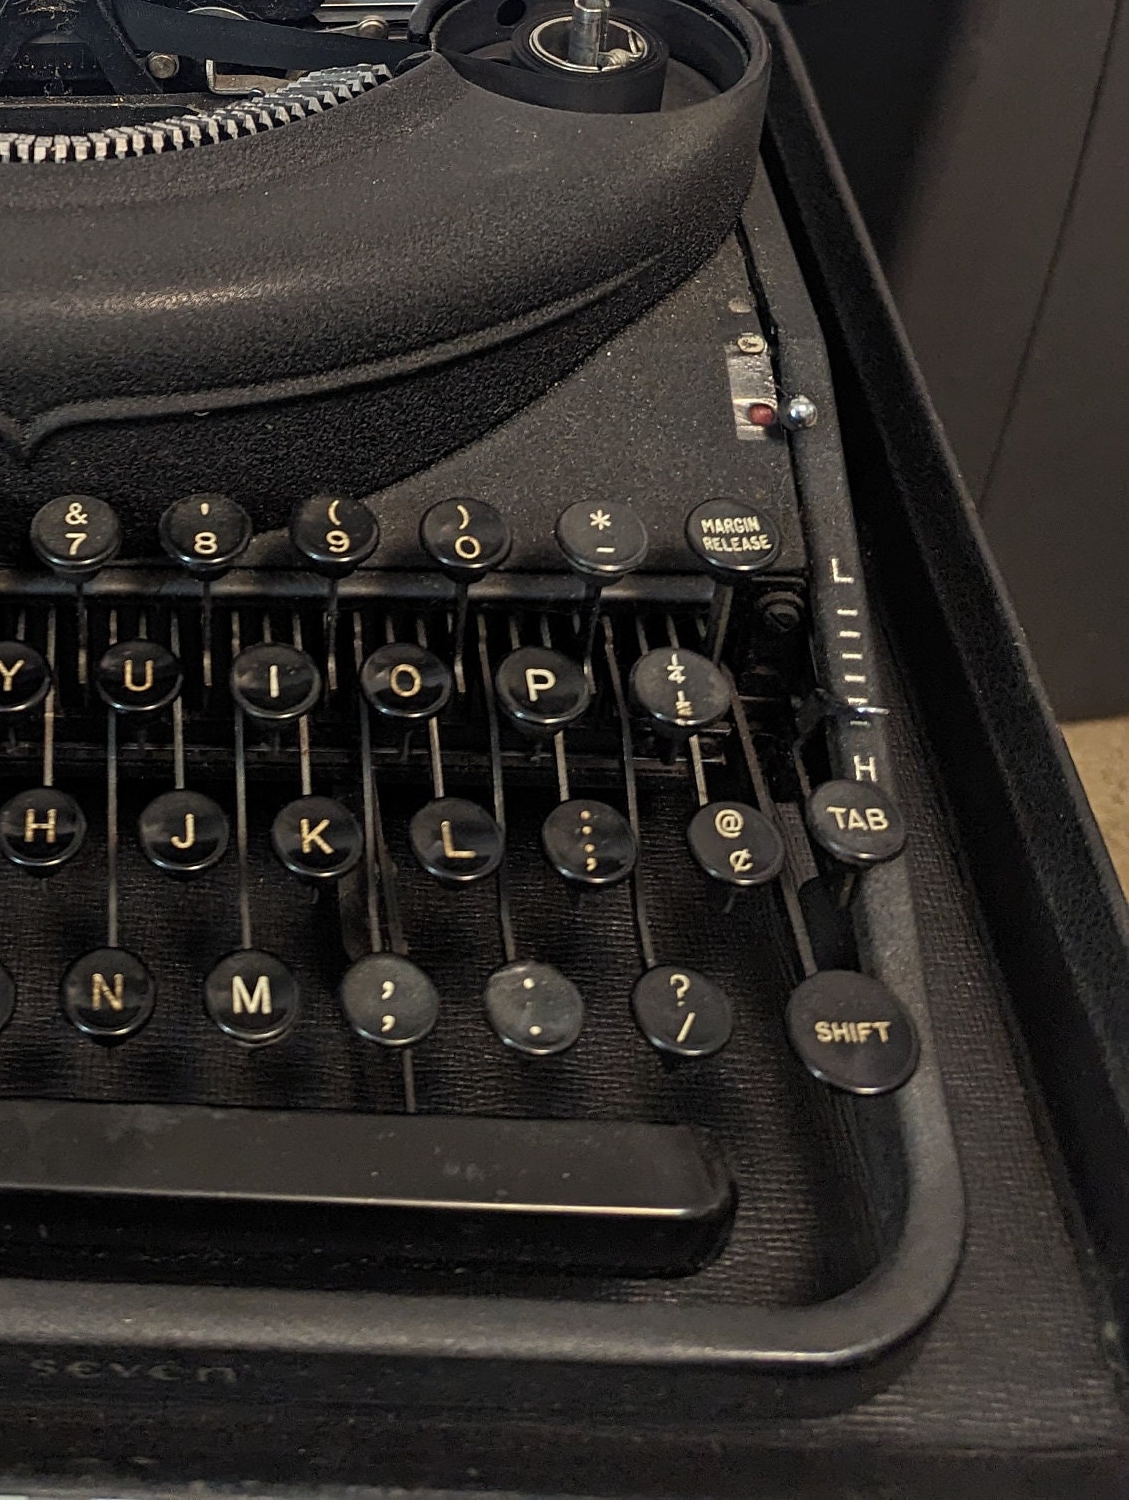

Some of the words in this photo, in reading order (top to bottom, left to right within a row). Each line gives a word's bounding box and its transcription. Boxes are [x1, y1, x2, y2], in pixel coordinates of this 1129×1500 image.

[65, 502, 88, 525] &
[700, 516, 761, 534] MARGIN
[64, 532, 87, 556] 7
[193, 531, 218, 555] 8
[326, 530, 350, 553] 9
[702, 534, 772, 552] RELEASE
[831, 557, 855, 584] L
[124, 659, 153, 692] U
[390, 663, 421, 697] O
[525, 668, 556, 702] P
[853, 754, 877, 782] H
[25, 808, 56, 842] H
[171, 813, 195, 849] J
[826, 806, 888, 831] TAB
[300, 818, 333, 854] K
[440, 820, 476, 858] L
[92, 973, 122, 1010] N
[232, 975, 271, 1014] M
[814, 1021, 890, 1043] SHIFT
